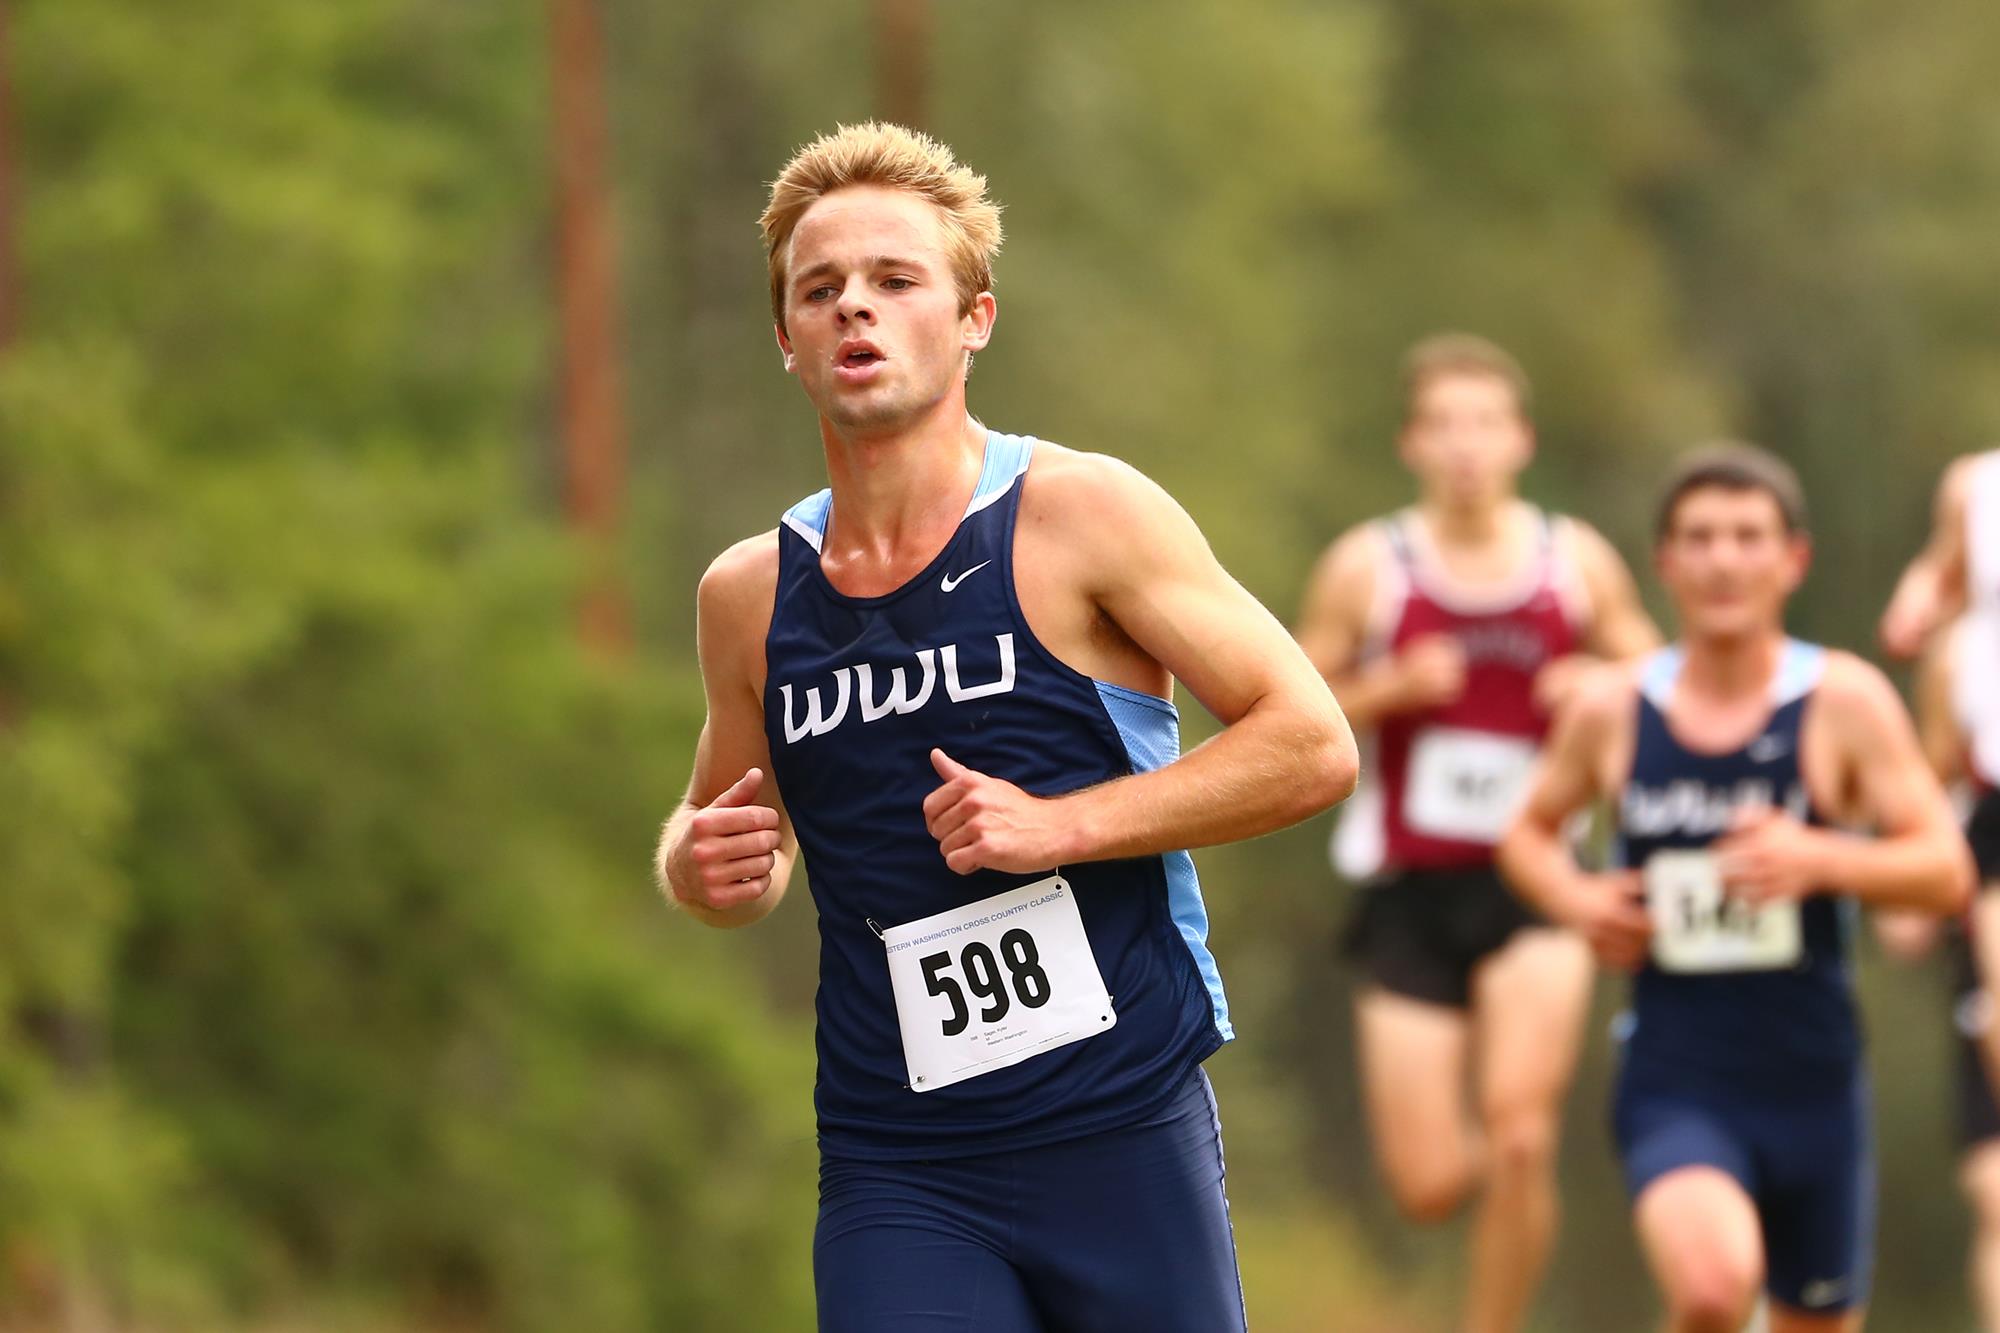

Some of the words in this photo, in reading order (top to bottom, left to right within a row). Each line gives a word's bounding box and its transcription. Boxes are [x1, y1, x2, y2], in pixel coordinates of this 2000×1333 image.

[778, 632, 1016, 745] WWU
[886, 941, 911, 954] STERN
[912, 925, 962, 946] WASHINGTON
[963, 916, 990, 930] CROSS
[990, 903, 1029, 922] COUNTRY
[1030, 891, 1063, 908] CLASSIC
[919, 928, 1051, 1036] 598
